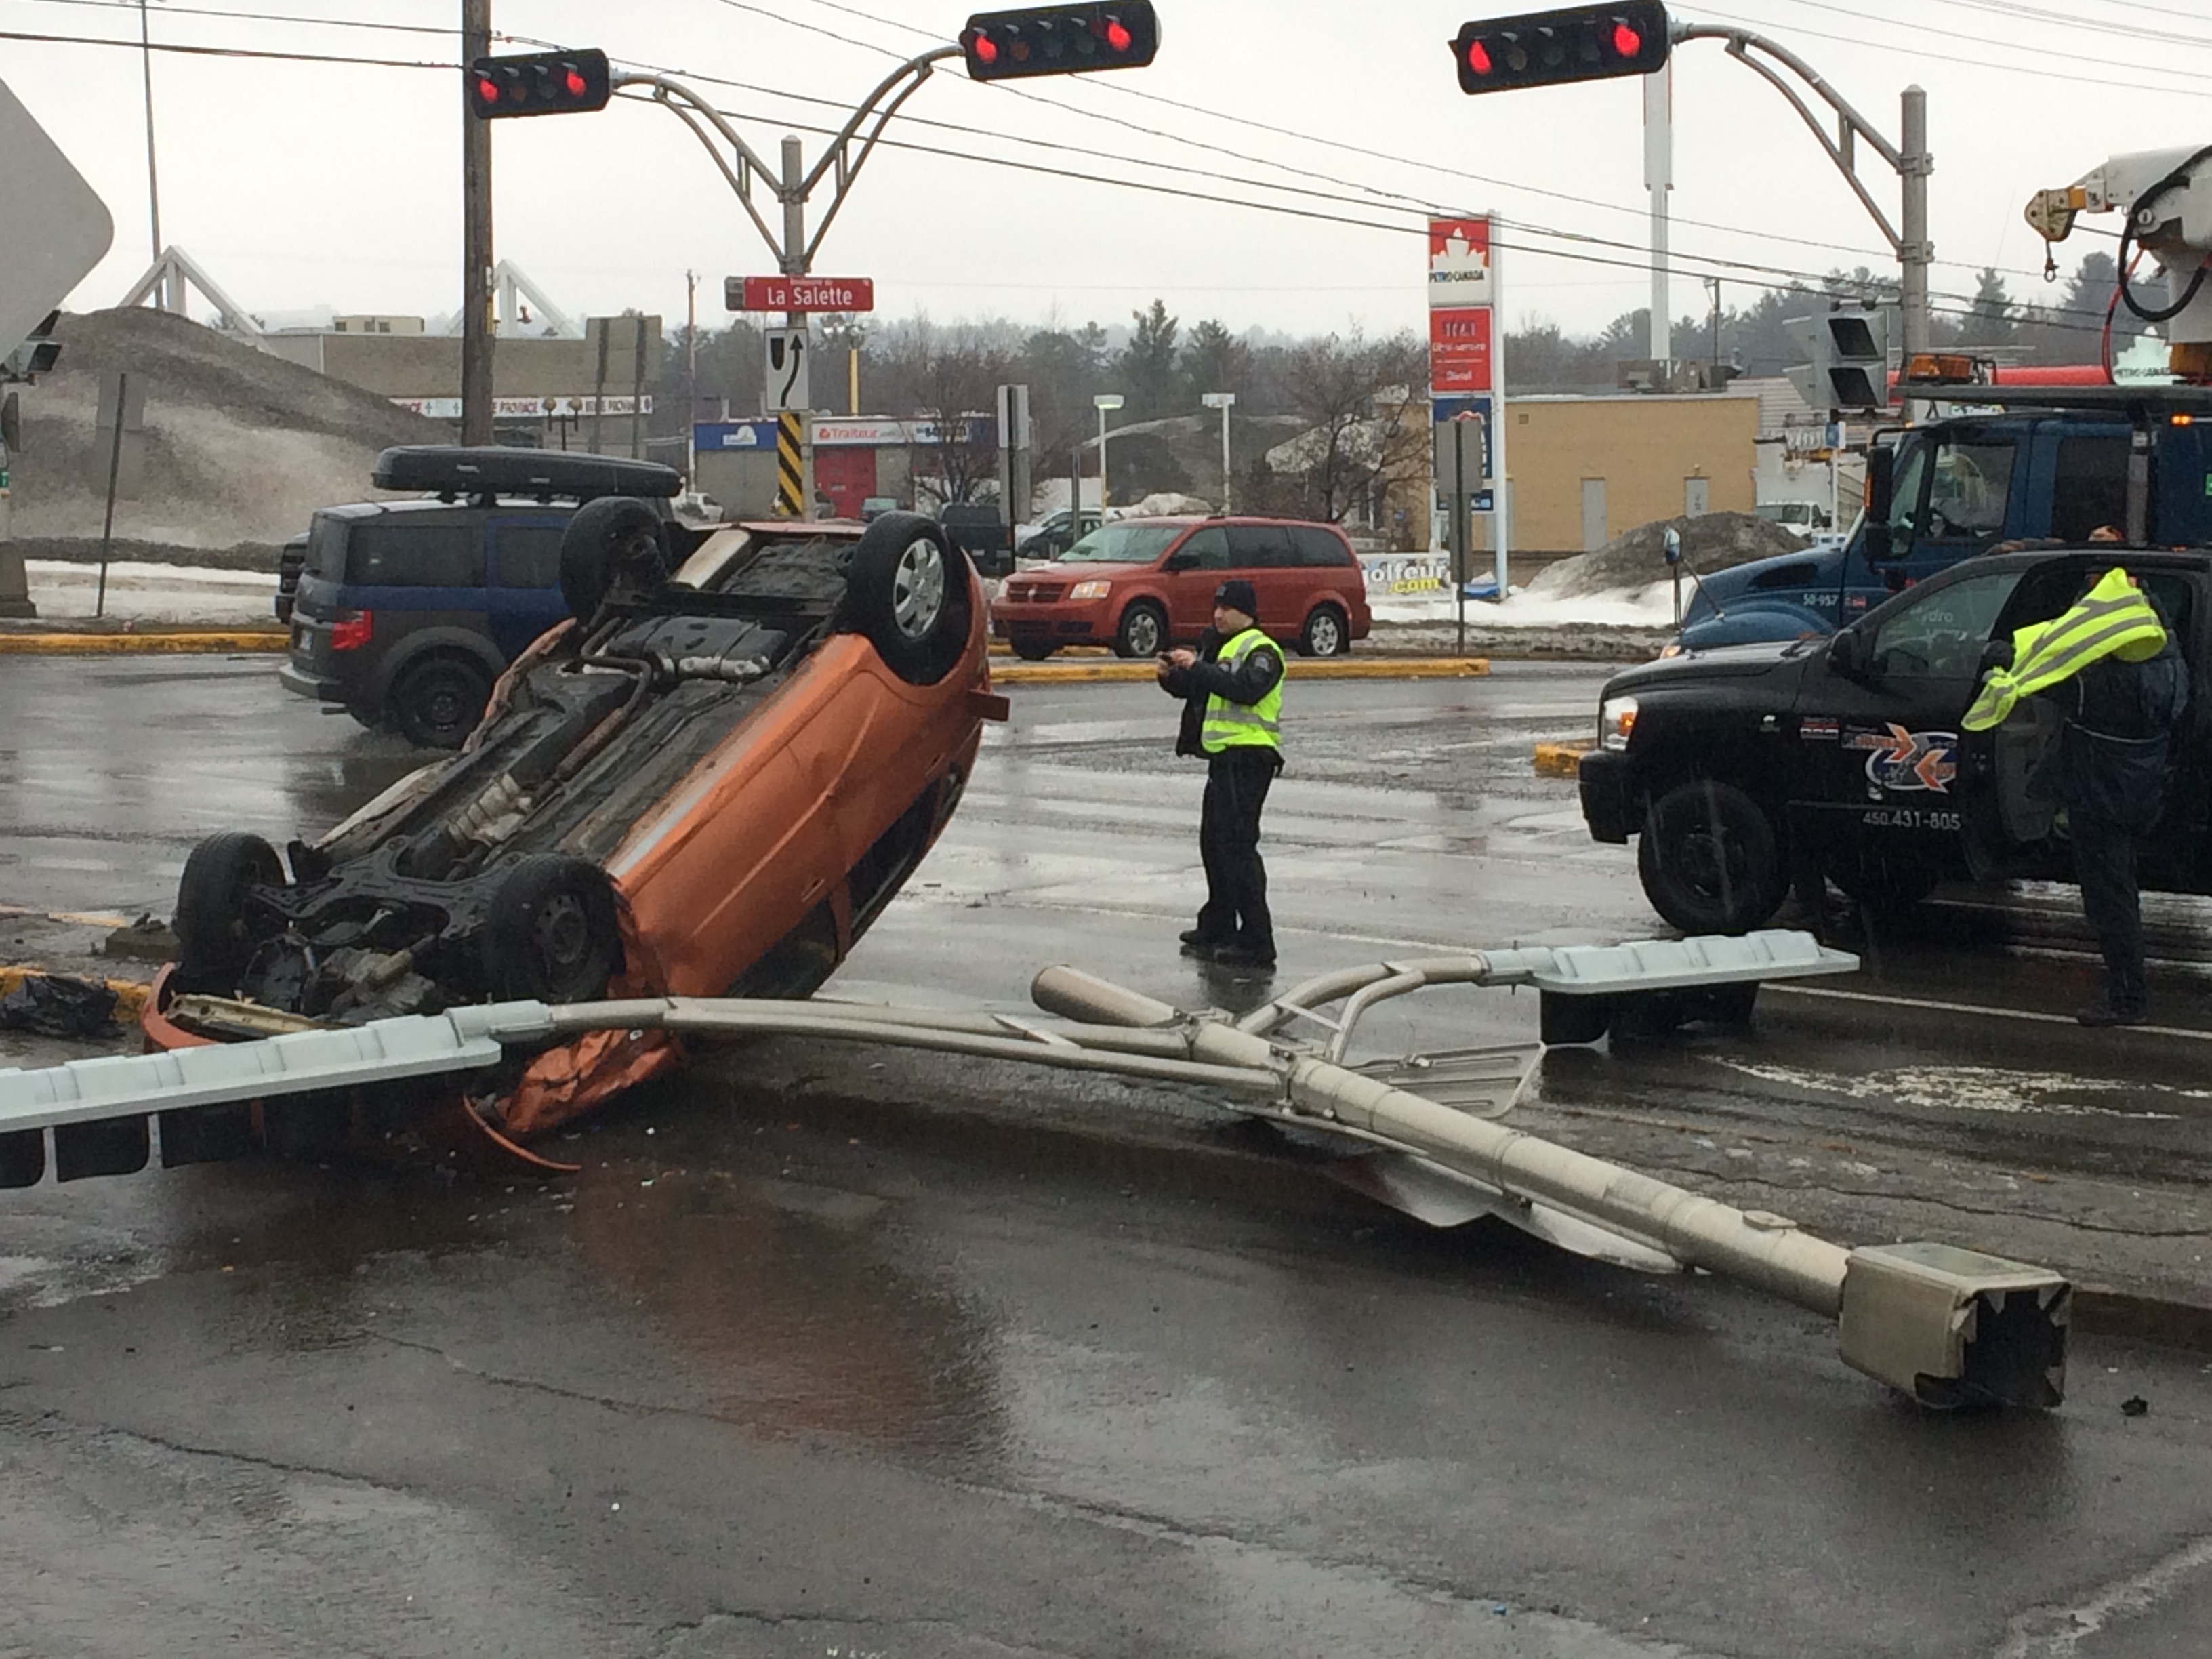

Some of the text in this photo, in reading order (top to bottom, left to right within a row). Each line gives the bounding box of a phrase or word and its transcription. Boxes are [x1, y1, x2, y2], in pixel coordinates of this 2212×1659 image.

[767, 286, 853, 305] La Salette
[1387, 577, 1439, 594] .com
